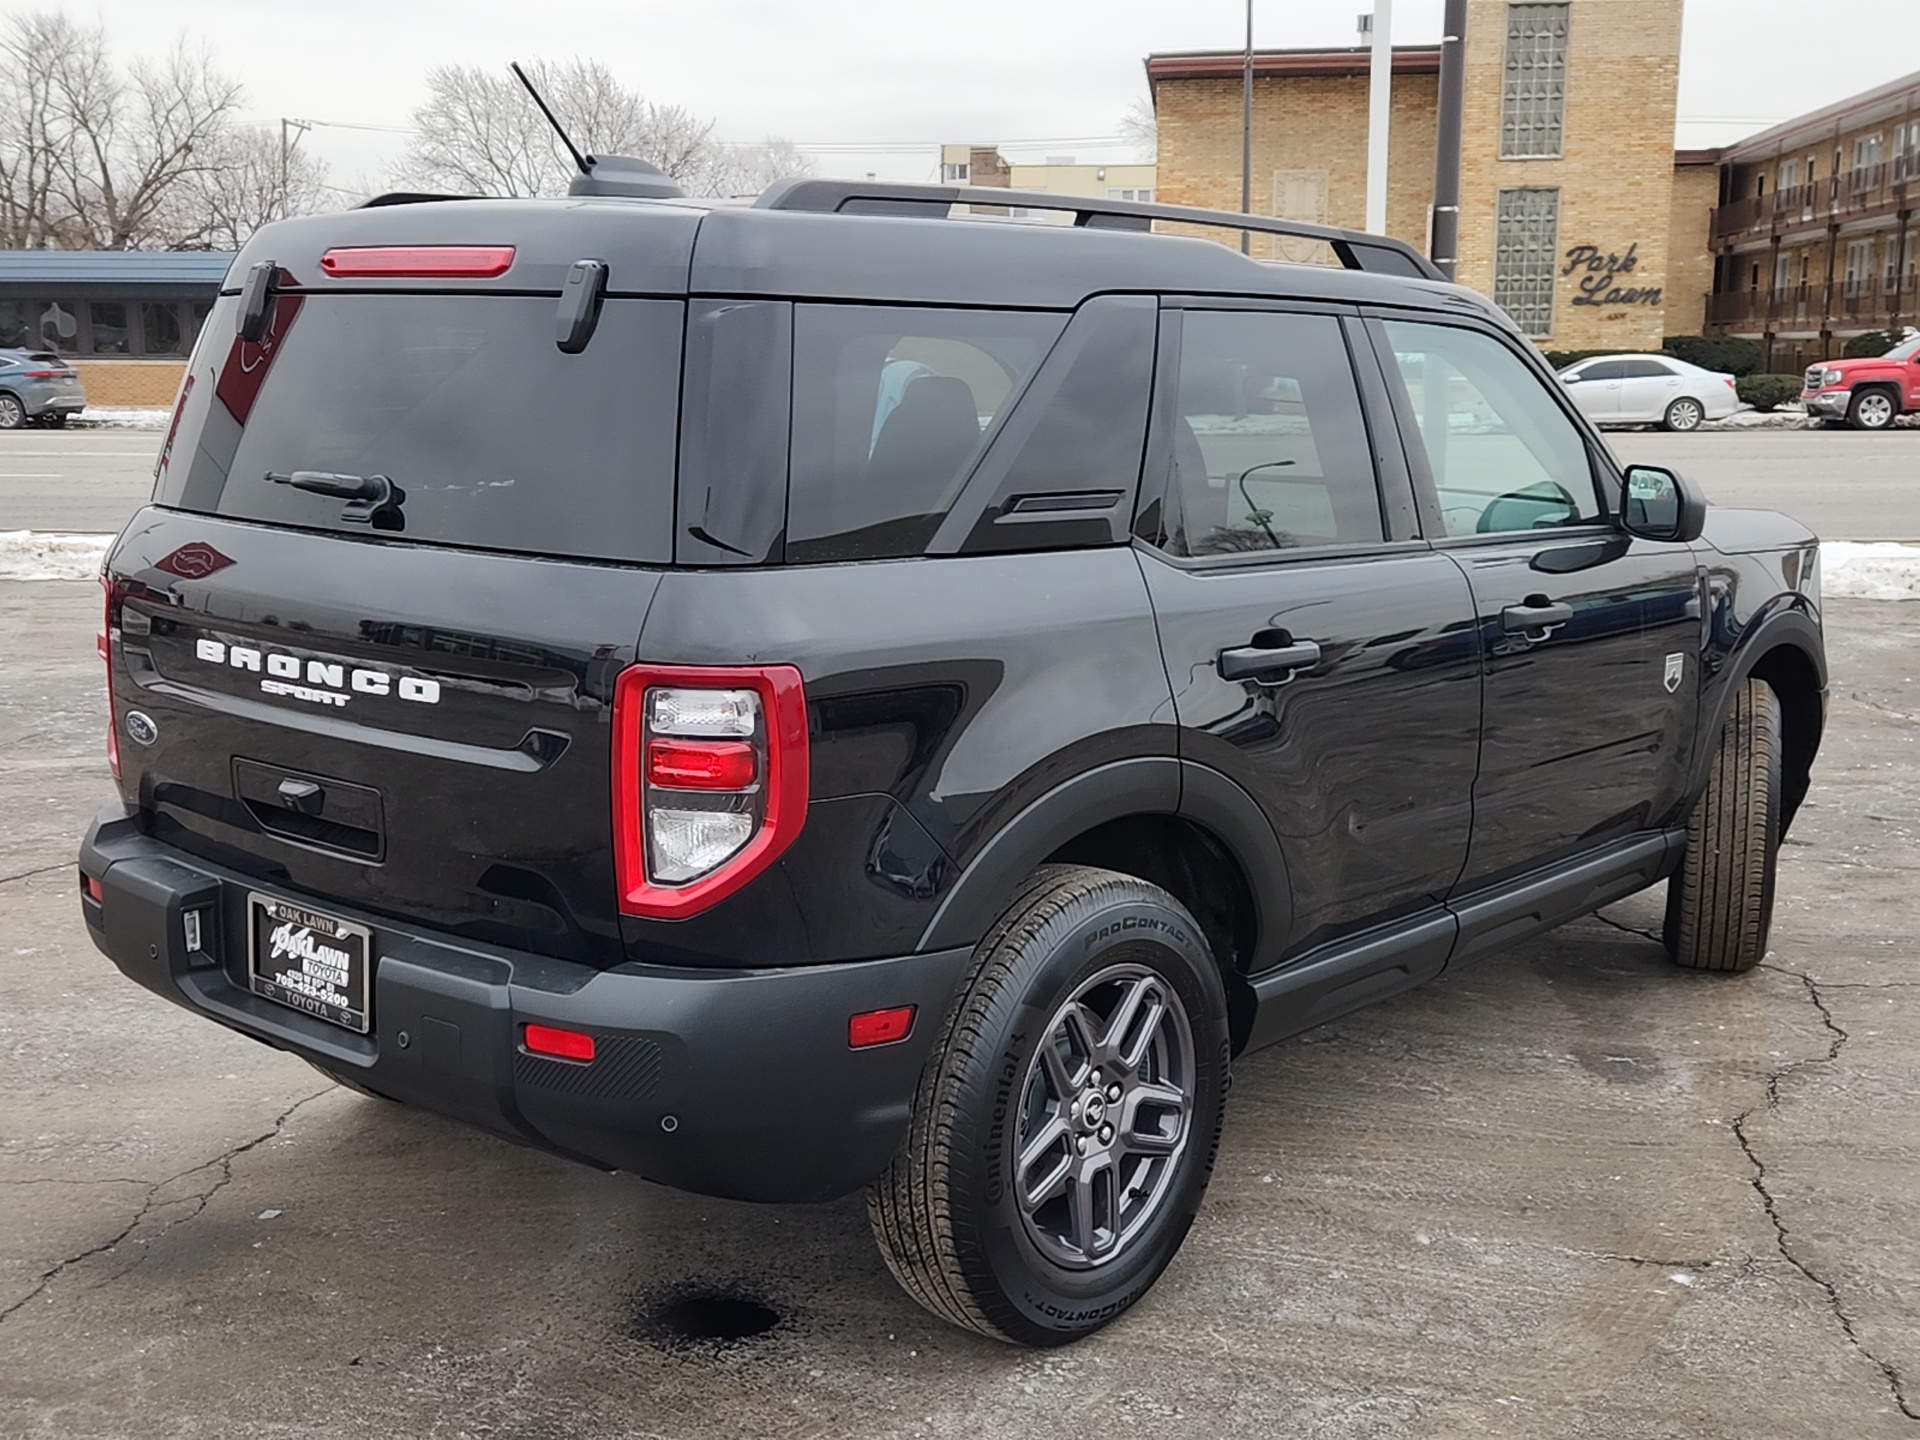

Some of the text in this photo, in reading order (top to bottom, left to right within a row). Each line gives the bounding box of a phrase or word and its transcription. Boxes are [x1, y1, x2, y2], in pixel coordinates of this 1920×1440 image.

[1562, 242, 1638, 275] Park
[1572, 274, 1662, 306] Lawn
[196, 638, 440, 704] BRONCO
[260, 679, 351, 707] SPORT
[279, 906, 334, 933] OAK LAWN
[308, 961, 343, 985] TOYOTA
[285, 991, 328, 1016] TOYOTA
